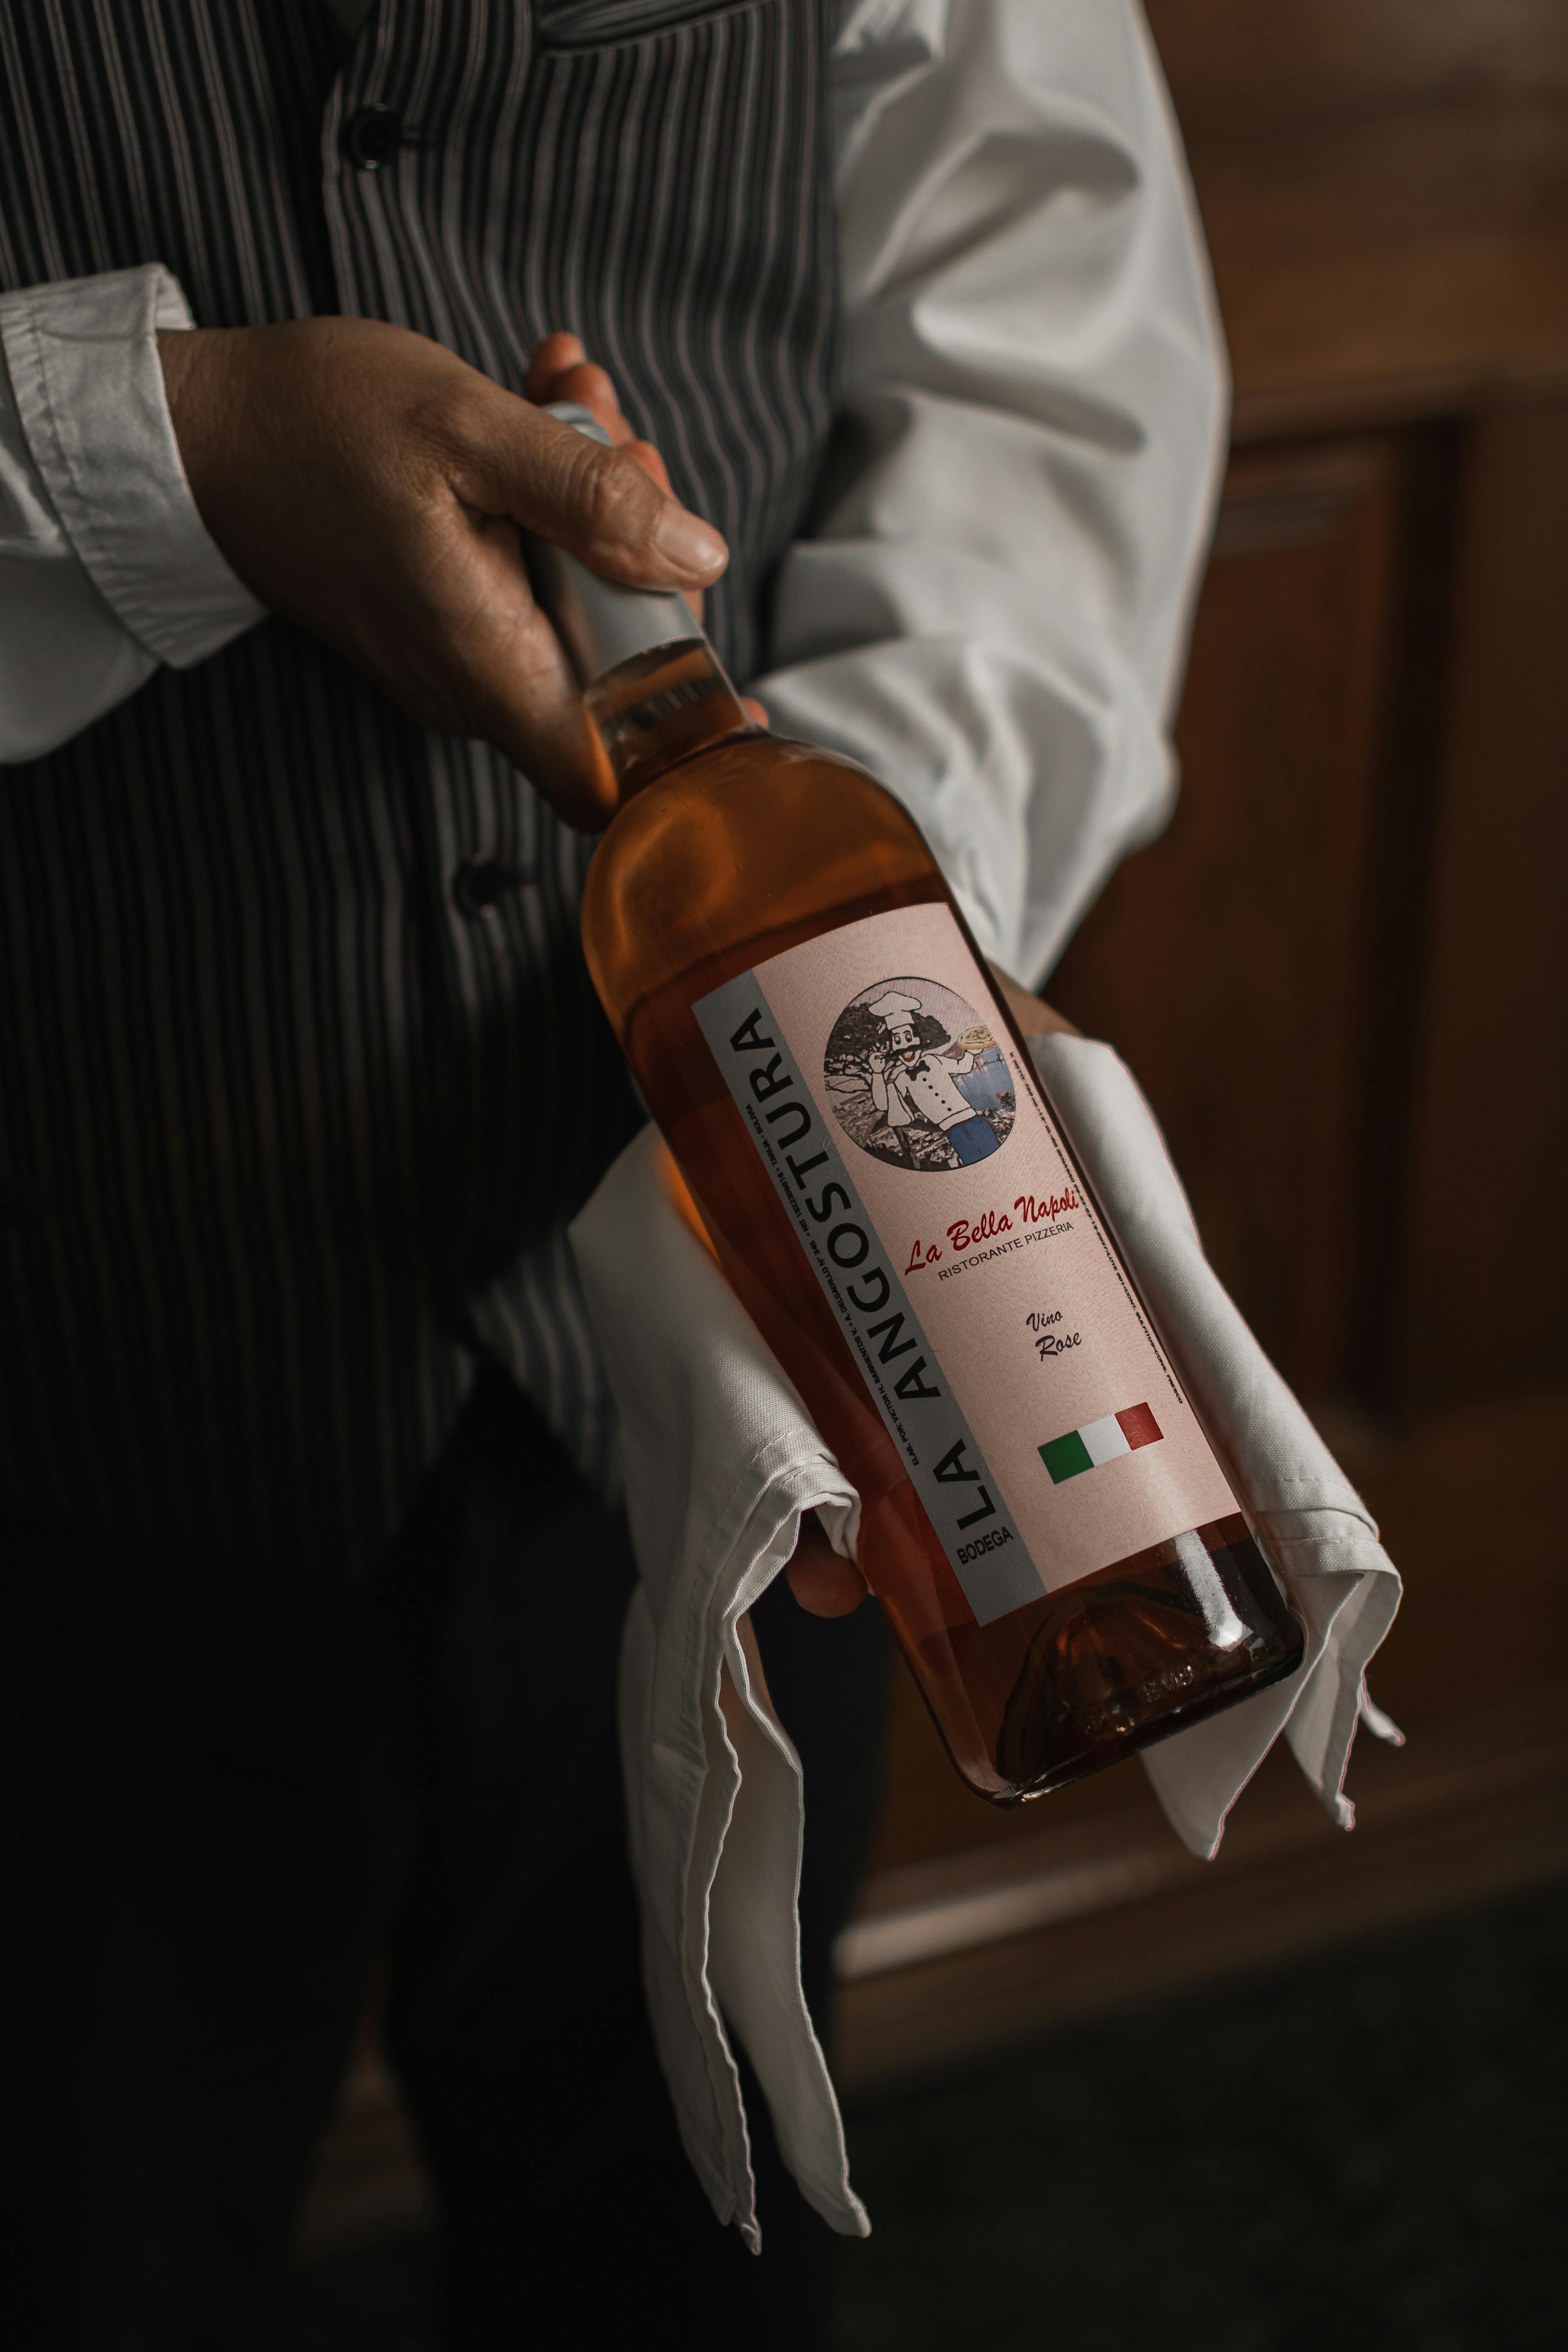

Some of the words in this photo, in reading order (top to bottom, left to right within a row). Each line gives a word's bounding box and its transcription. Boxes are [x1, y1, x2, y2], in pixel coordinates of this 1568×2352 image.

[745, 1102, 764, 1135] BOLIVIA
[762, 1138, 778, 1167] TARIJA
[729, 1007, 941, 1400] ANGOSTURA
[798, 1218, 809, 1233] NIT
[904, 1240, 942, 1276] La
[946, 1210, 1013, 1252] Bella
[1014, 1187, 1078, 1223] Napoli
[808, 1239, 820, 1256] 345
[938, 1238, 1024, 1281] RISTORANTE
[1024, 1221, 1074, 1244] PIZZERIA
[821, 1266, 847, 1313] DELGADILLO
[844, 1312, 852, 1321] A.
[850, 1326, 858, 1337] V.
[1026, 1311, 1063, 1332] Vino
[853, 1335, 881, 1385] BARRIENTOS
[1035, 1332, 1082, 1362] Rose
[877, 1383, 886, 1394] H.
[881, 1393, 899, 1424] VICTOR
[905, 1442, 920, 1466] ELAB.
[933, 1438, 996, 1531] LA
[956, 1526, 1014, 1565] BODEGA
